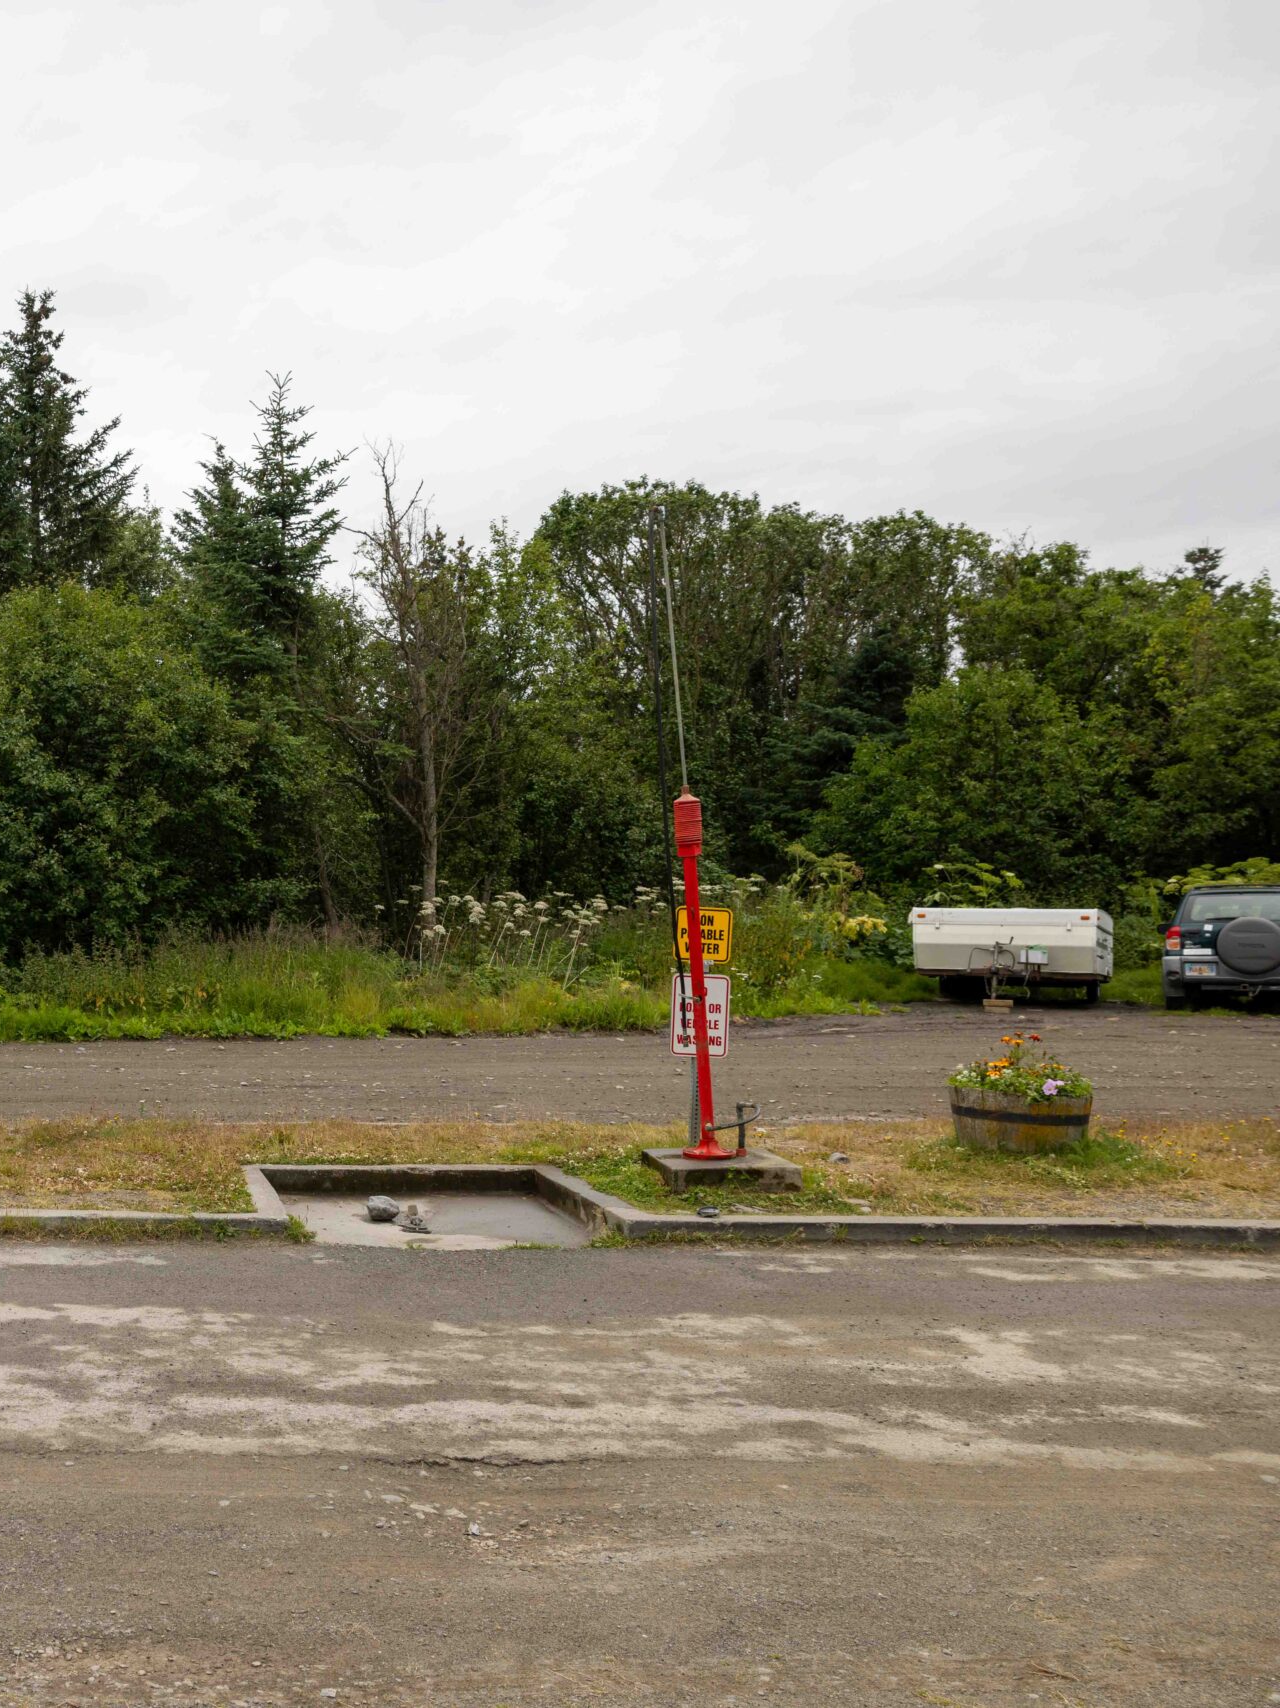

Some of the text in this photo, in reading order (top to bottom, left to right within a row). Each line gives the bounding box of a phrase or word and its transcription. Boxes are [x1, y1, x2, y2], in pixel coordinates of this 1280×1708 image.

[698, 914, 714, 926] ON
[680, 928, 725, 941] PABLE
[708, 1004, 722, 1014] OR
